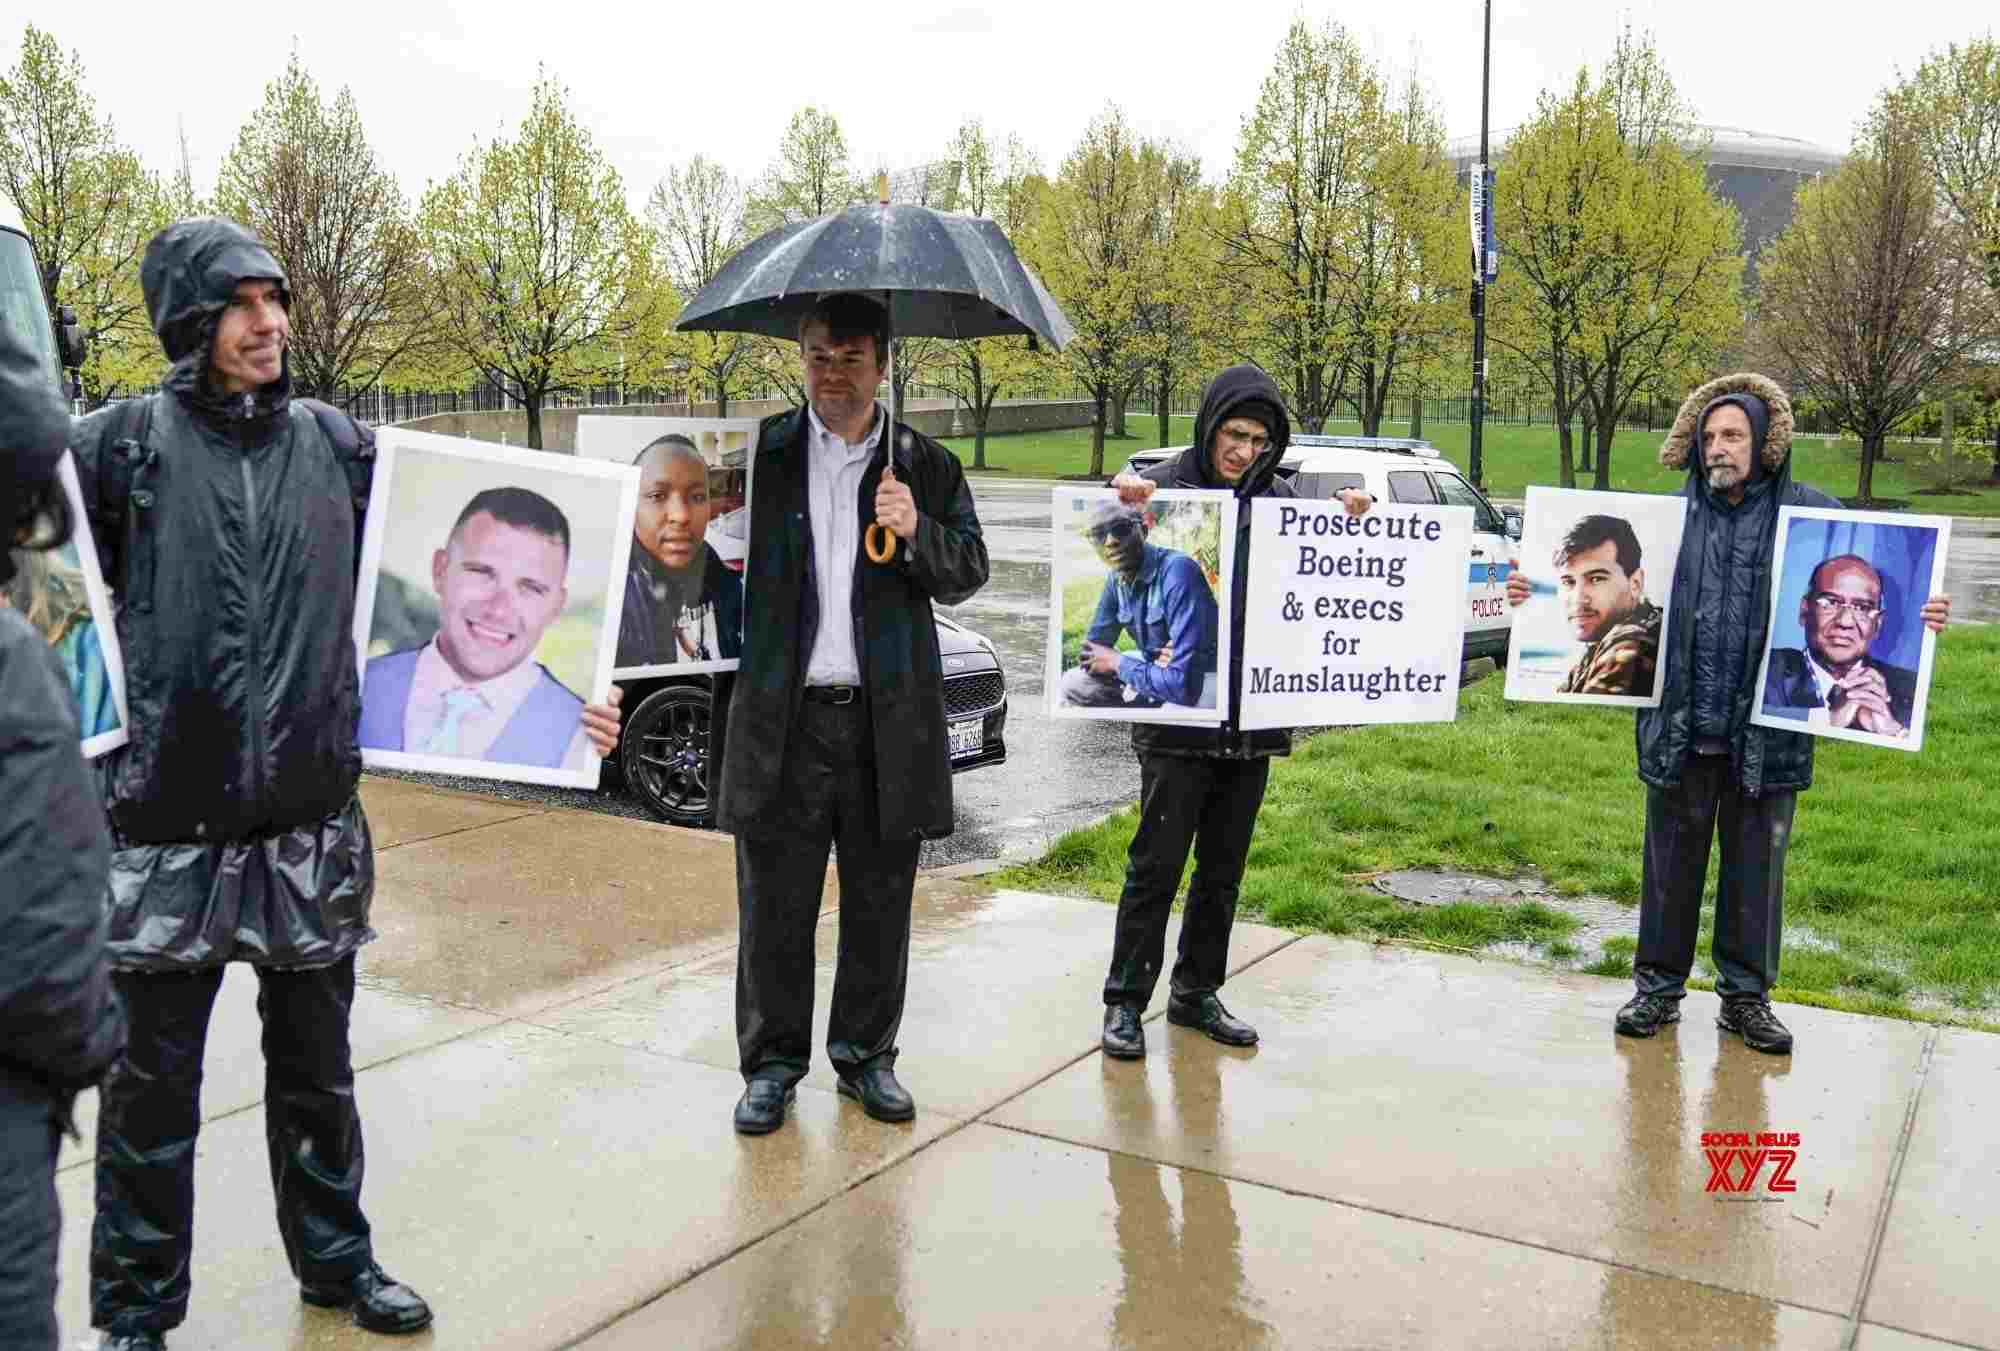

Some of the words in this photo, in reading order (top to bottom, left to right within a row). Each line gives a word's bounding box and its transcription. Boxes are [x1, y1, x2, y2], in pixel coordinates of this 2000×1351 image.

[1279, 506, 1440, 540] Prosecute
[1297, 546, 1406, 587] Boeing
[1282, 592, 1304, 621] &
[1315, 596, 1403, 621] execs
[1472, 598, 1503, 618] POLICE
[1322, 630, 1360, 656] for
[1250, 666, 1446, 700] Manslaughter
